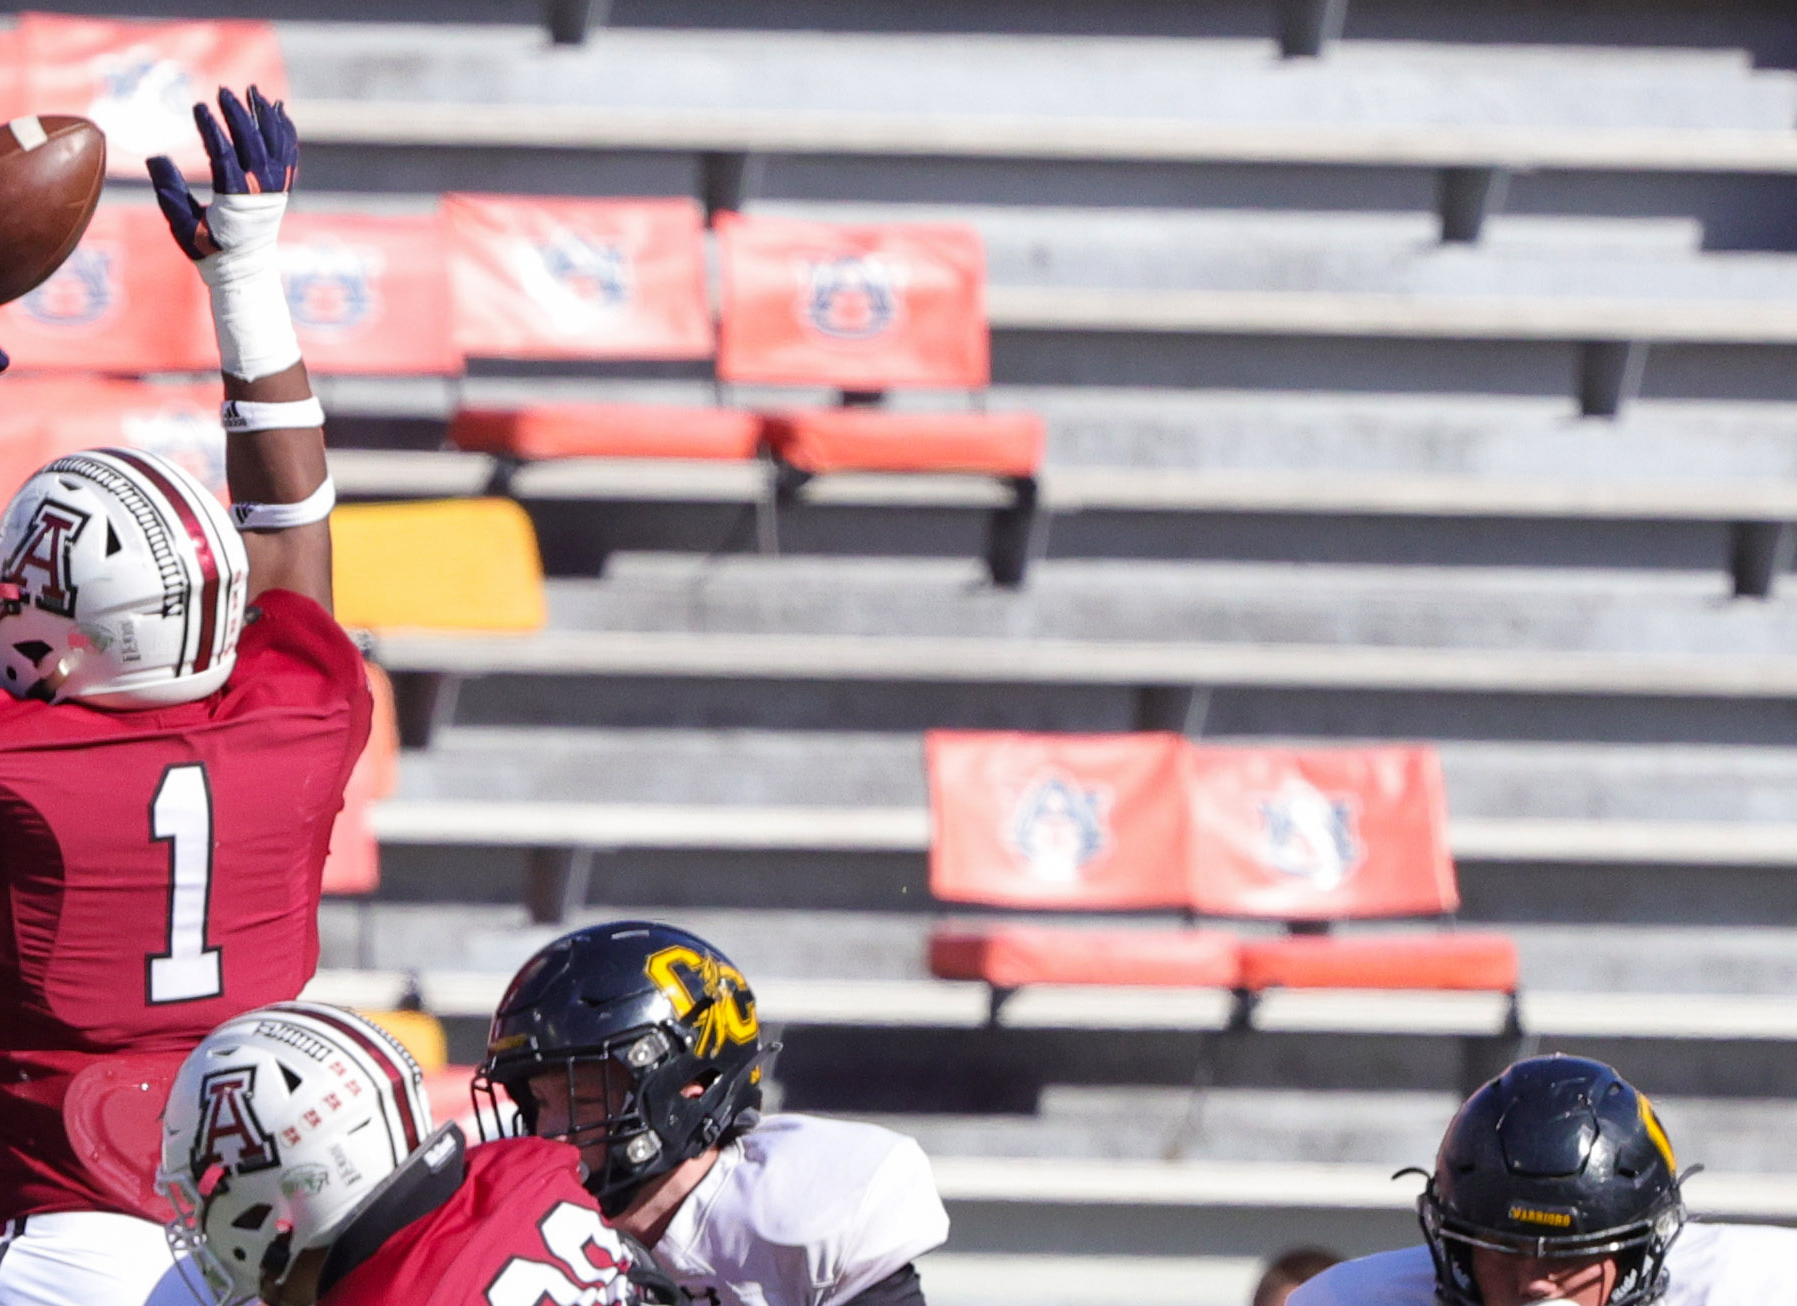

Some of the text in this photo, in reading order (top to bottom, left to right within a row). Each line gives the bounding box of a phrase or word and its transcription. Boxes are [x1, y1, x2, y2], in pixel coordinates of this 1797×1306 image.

[0, 496, 92, 619] A
[145, 762, 224, 1007] 1
[189, 1064, 282, 1184] A
